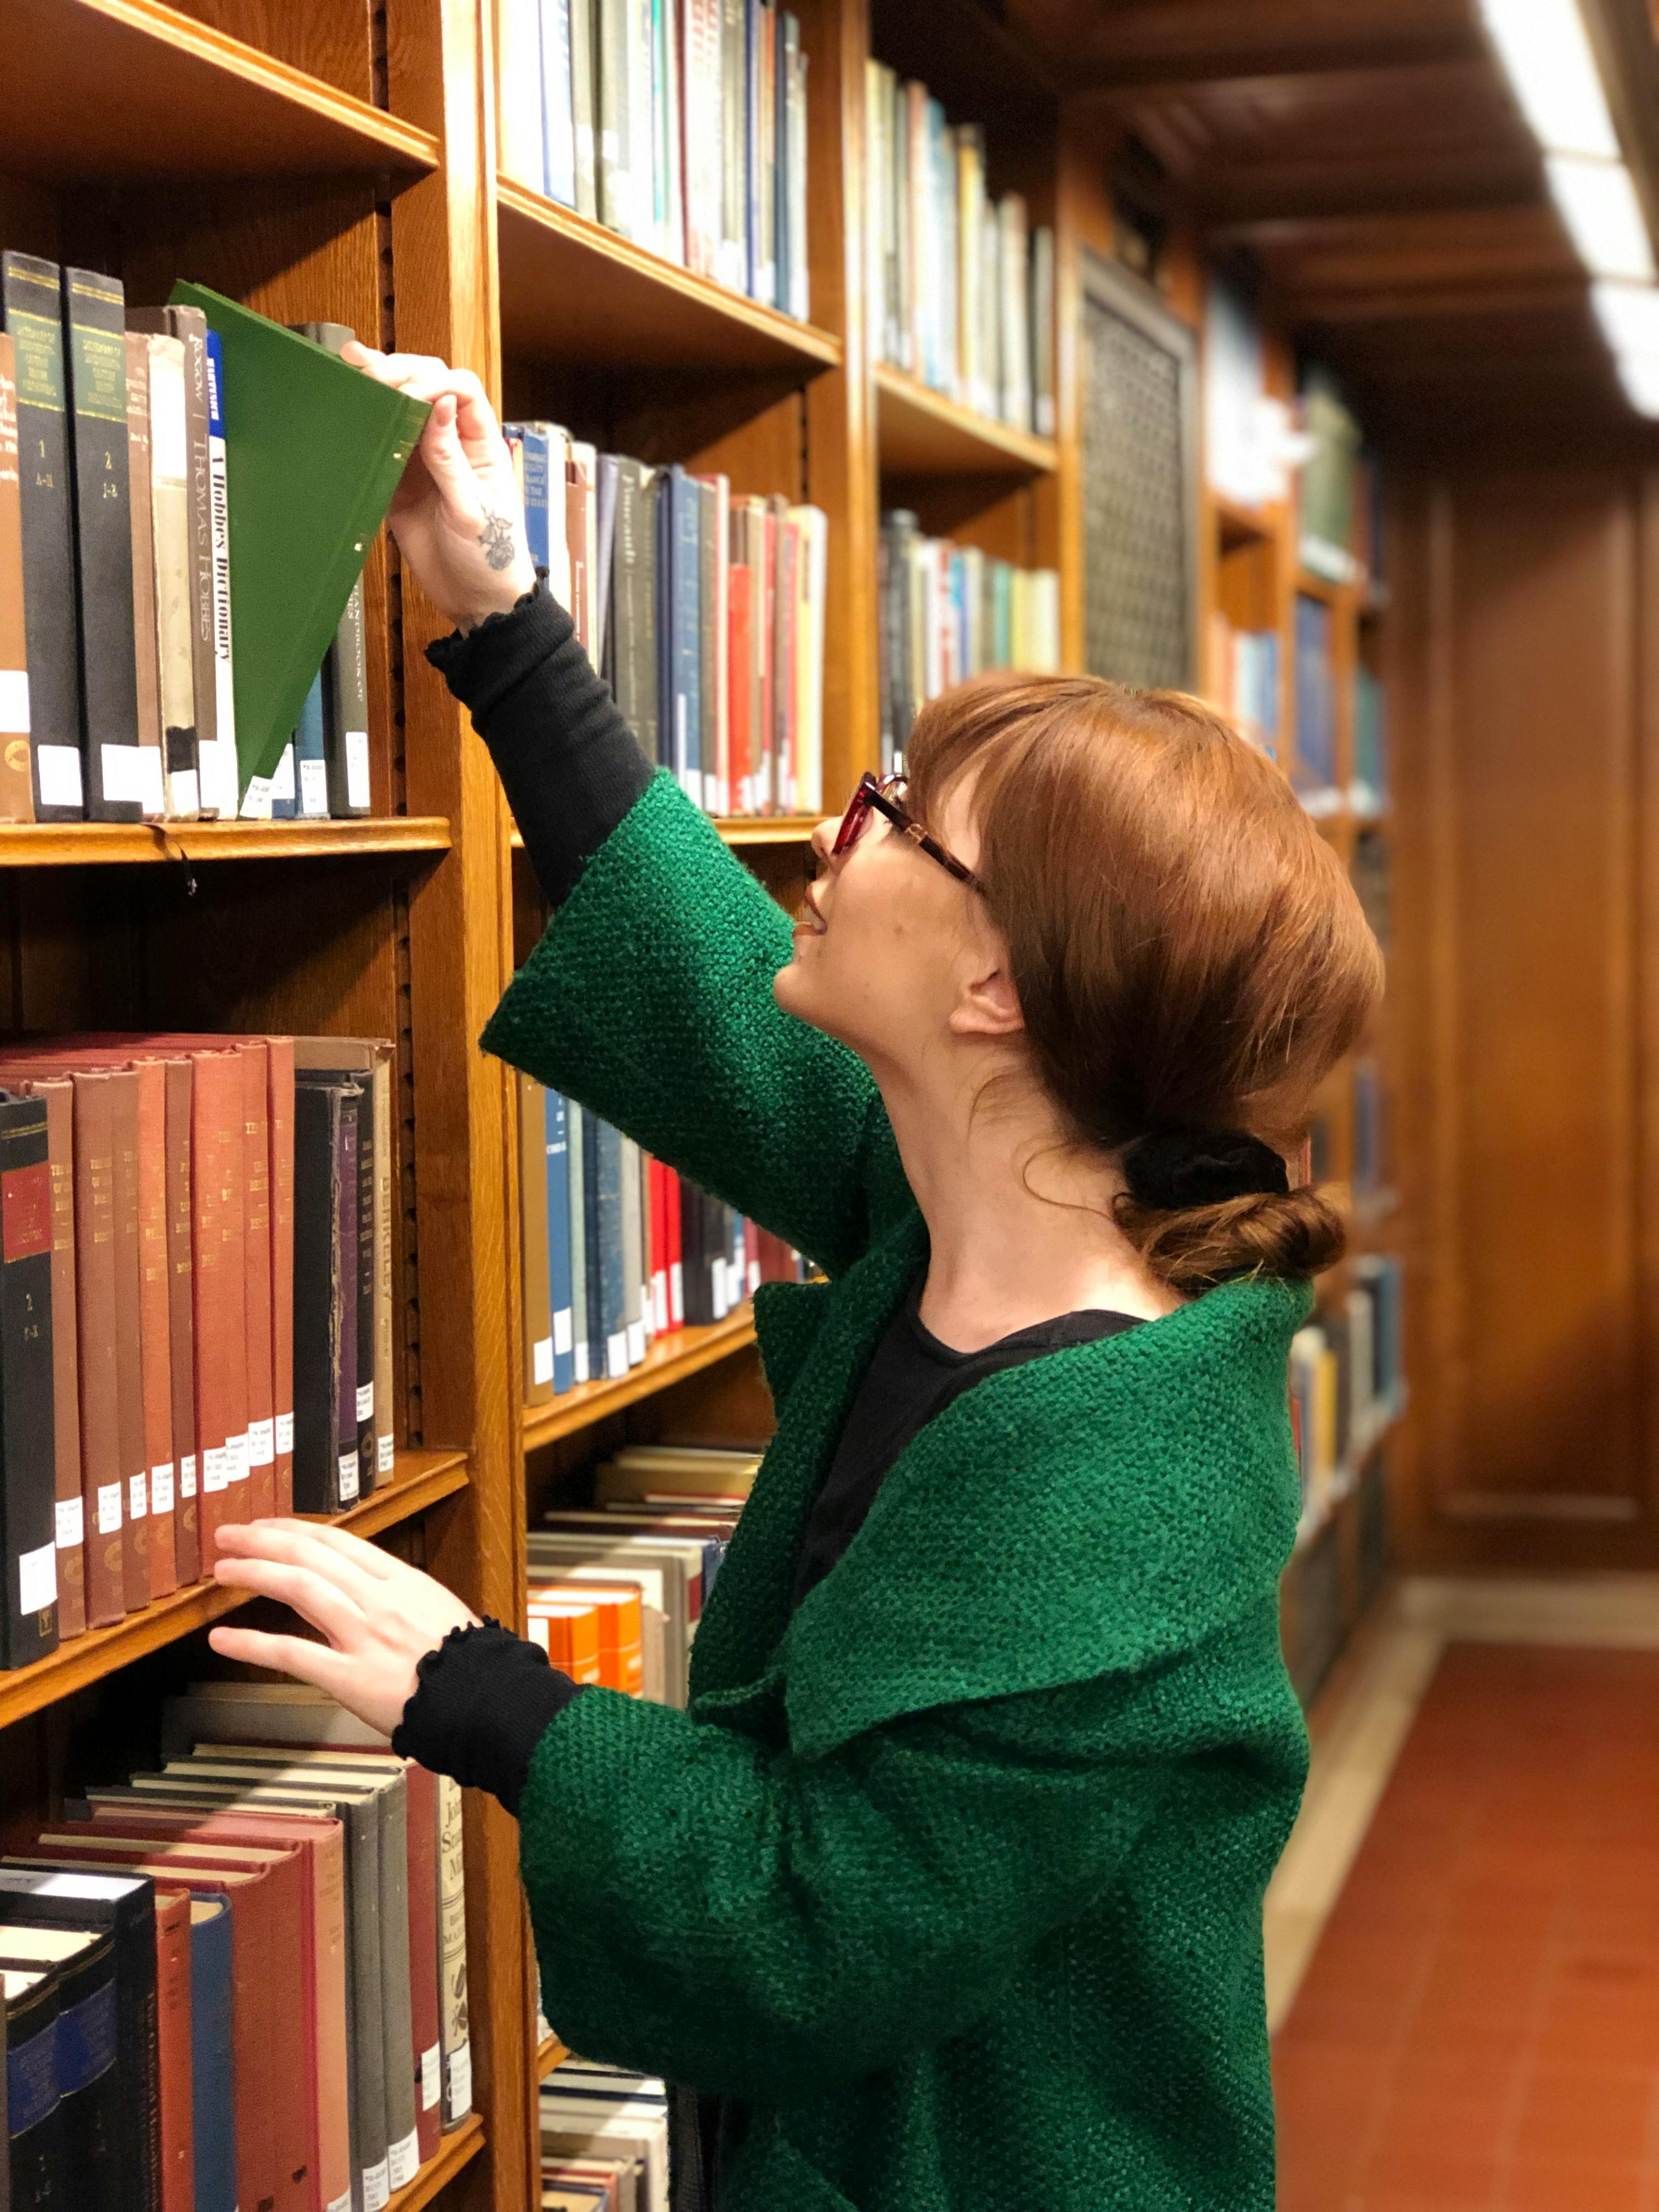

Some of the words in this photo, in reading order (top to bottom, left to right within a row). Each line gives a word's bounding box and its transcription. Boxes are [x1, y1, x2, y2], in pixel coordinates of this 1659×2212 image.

[189, 333, 203, 403] ROGOW
[194, 434, 208, 546] THOMAS
[212, 473, 227, 549] Hobbes
[199, 555, 212, 641] HOBBES
[216, 557, 230, 663] Dictionary
